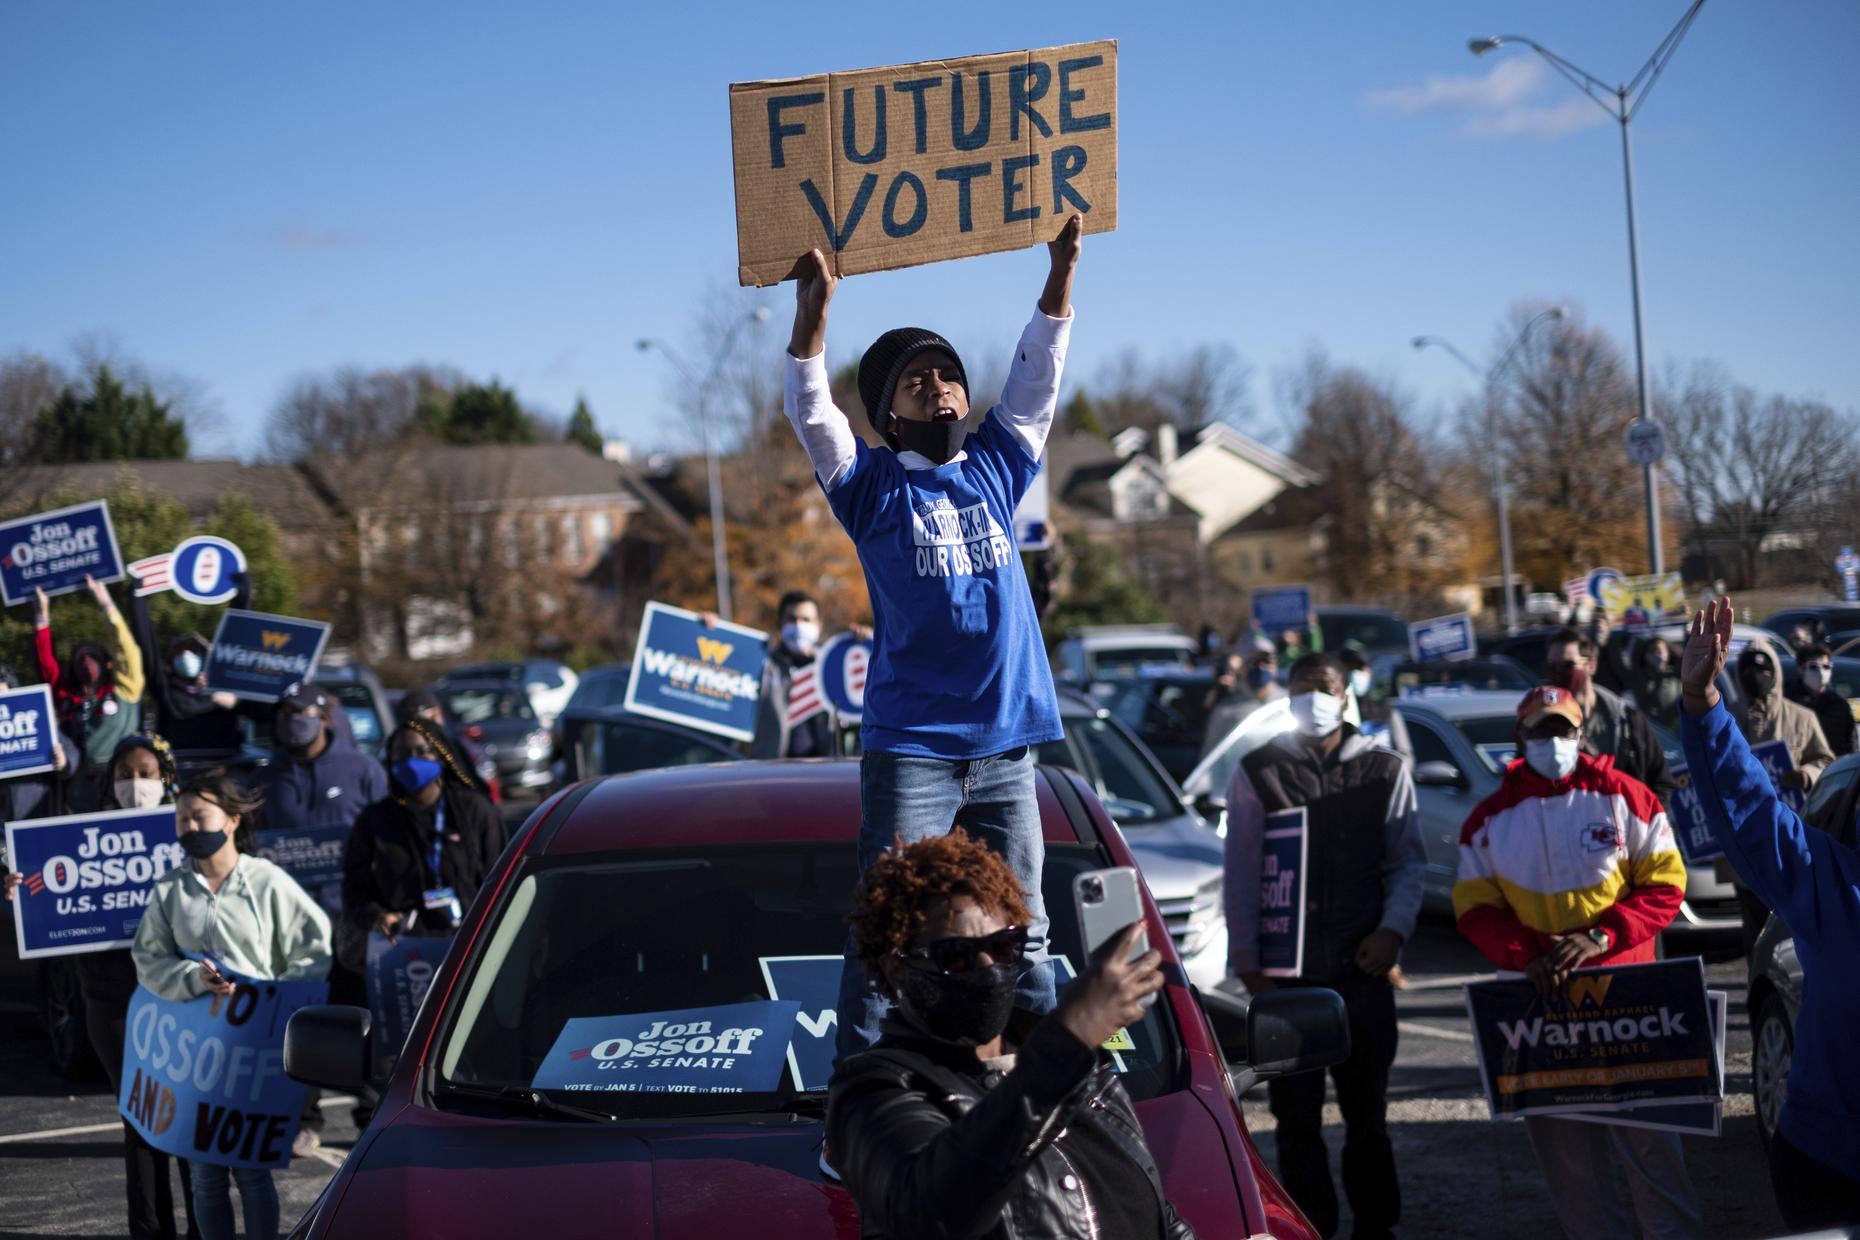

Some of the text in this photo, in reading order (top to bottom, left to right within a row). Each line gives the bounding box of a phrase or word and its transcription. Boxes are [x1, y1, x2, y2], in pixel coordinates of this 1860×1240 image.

[767, 55, 1112, 169] FUTURE
[800, 145, 1092, 251] VOTER
[10, 525, 99, 568] Ossoff
[30, 523, 72, 544] Jon
[22, 550, 101, 580] U.S. SENATE
[916, 546, 950, 577] OUR
[215, 642, 311, 675] Warnock
[644, 647, 760, 701] Warnock
[0, 709, 39, 739] off
[0, 735, 39, 756] NATE
[78, 827, 147, 859] Jon
[43, 841, 186, 894] Ossoff
[56, 888, 153, 915] U.S. SEN
[1604, 1004, 1656, 1019] RAPHAEL
[638, 1021, 712, 1041] Jon
[1497, 1006, 1689, 1050] Warnock
[132, 1002, 288, 1102] OSSOFF
[590, 1028, 764, 1061] Ossoff
[1552, 1041, 1649, 1061] U.S. SENATE
[597, 1057, 735, 1070] U.S. SENATE
[1612, 1064, 1673, 1081] JANUARY
[127, 1066, 177, 1137] AND
[564, 1083, 593, 1092] VOTE
[604, 1083, 627, 1092] JAN
[628, 1083, 636, 1092] 5
[667, 1084, 697, 1093] VOTE
[194, 1101, 291, 1163] VOTE
